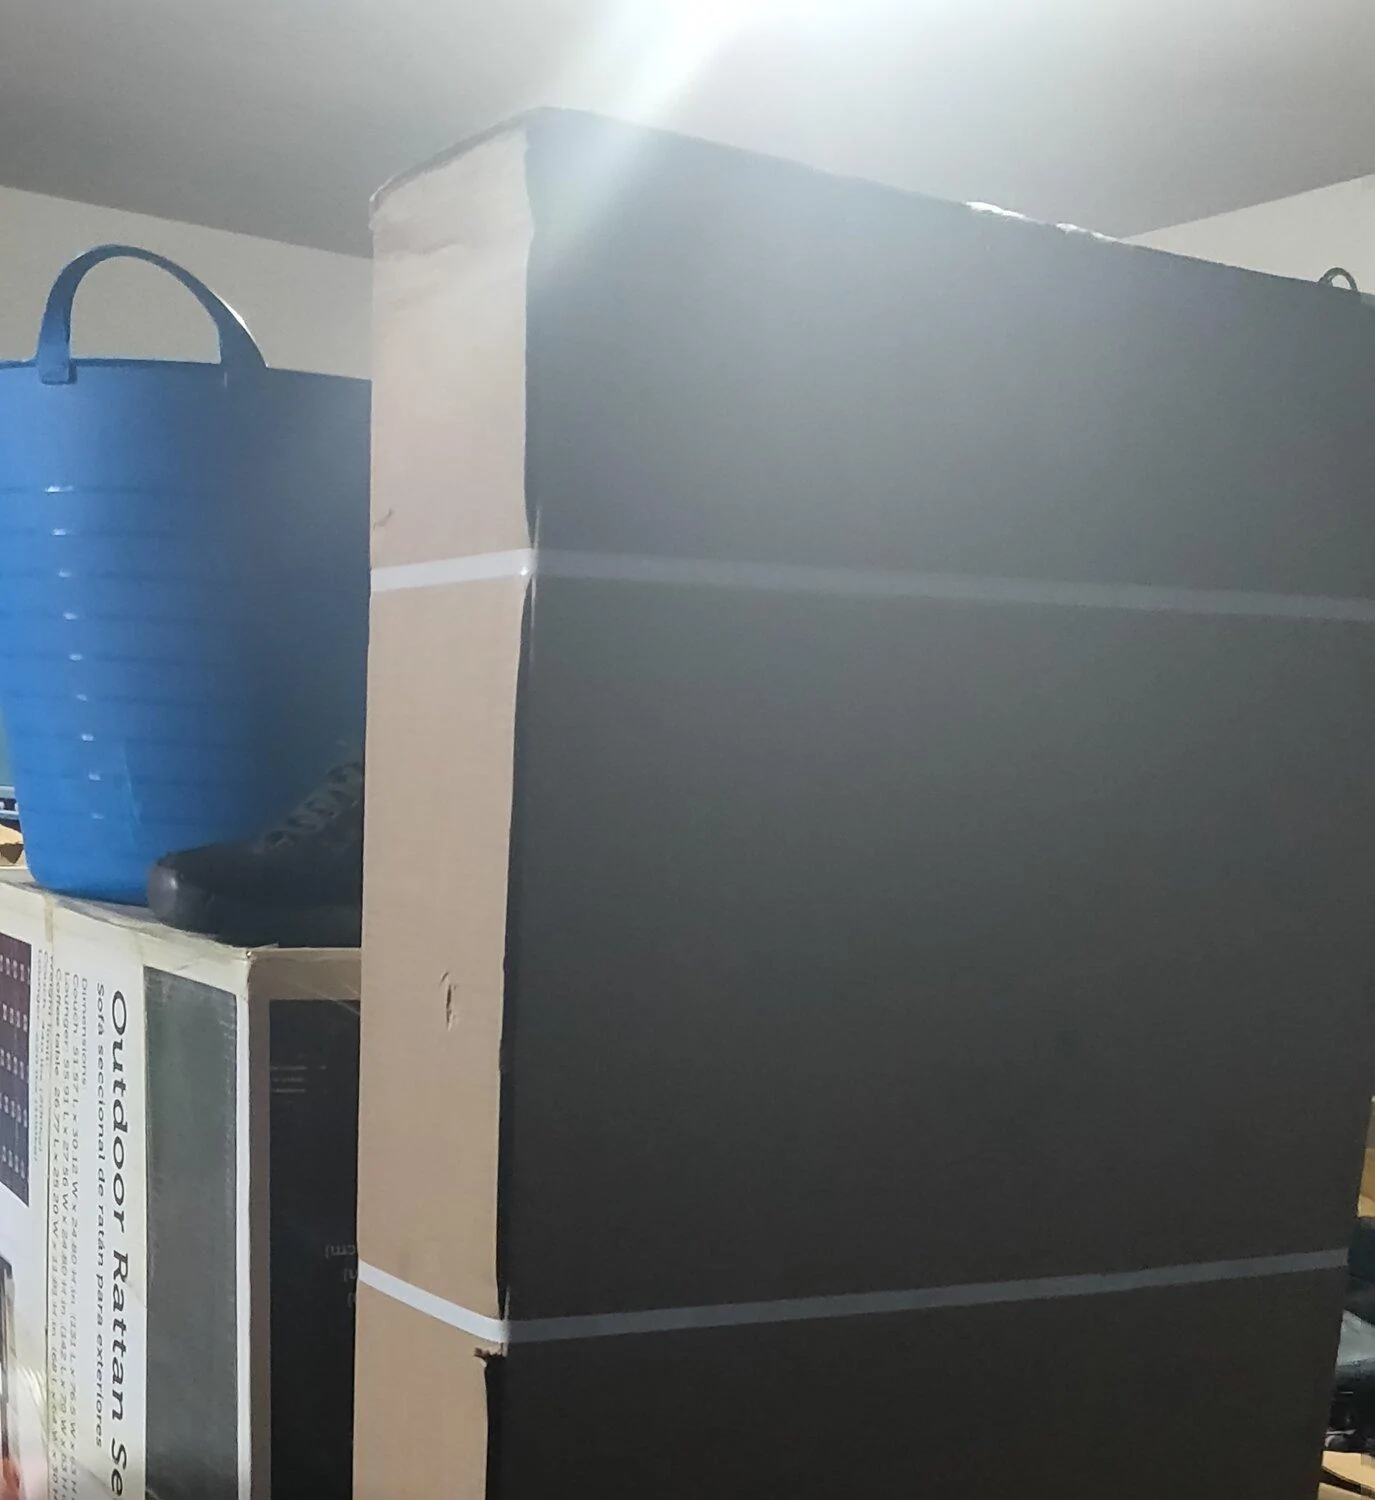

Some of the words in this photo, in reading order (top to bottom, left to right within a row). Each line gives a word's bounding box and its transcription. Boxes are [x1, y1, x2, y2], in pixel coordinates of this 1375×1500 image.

[97, 1045, 106, 1159] seccional
[111, 990, 129, 1233] Outdoor
[97, 1167, 105, 1196] de
[97, 1204, 106, 1266] ratán
[95, 1273, 104, 1325] para
[111, 1249, 129, 1420] Rattan
[96, 1333, 105, 1448] exteriores
